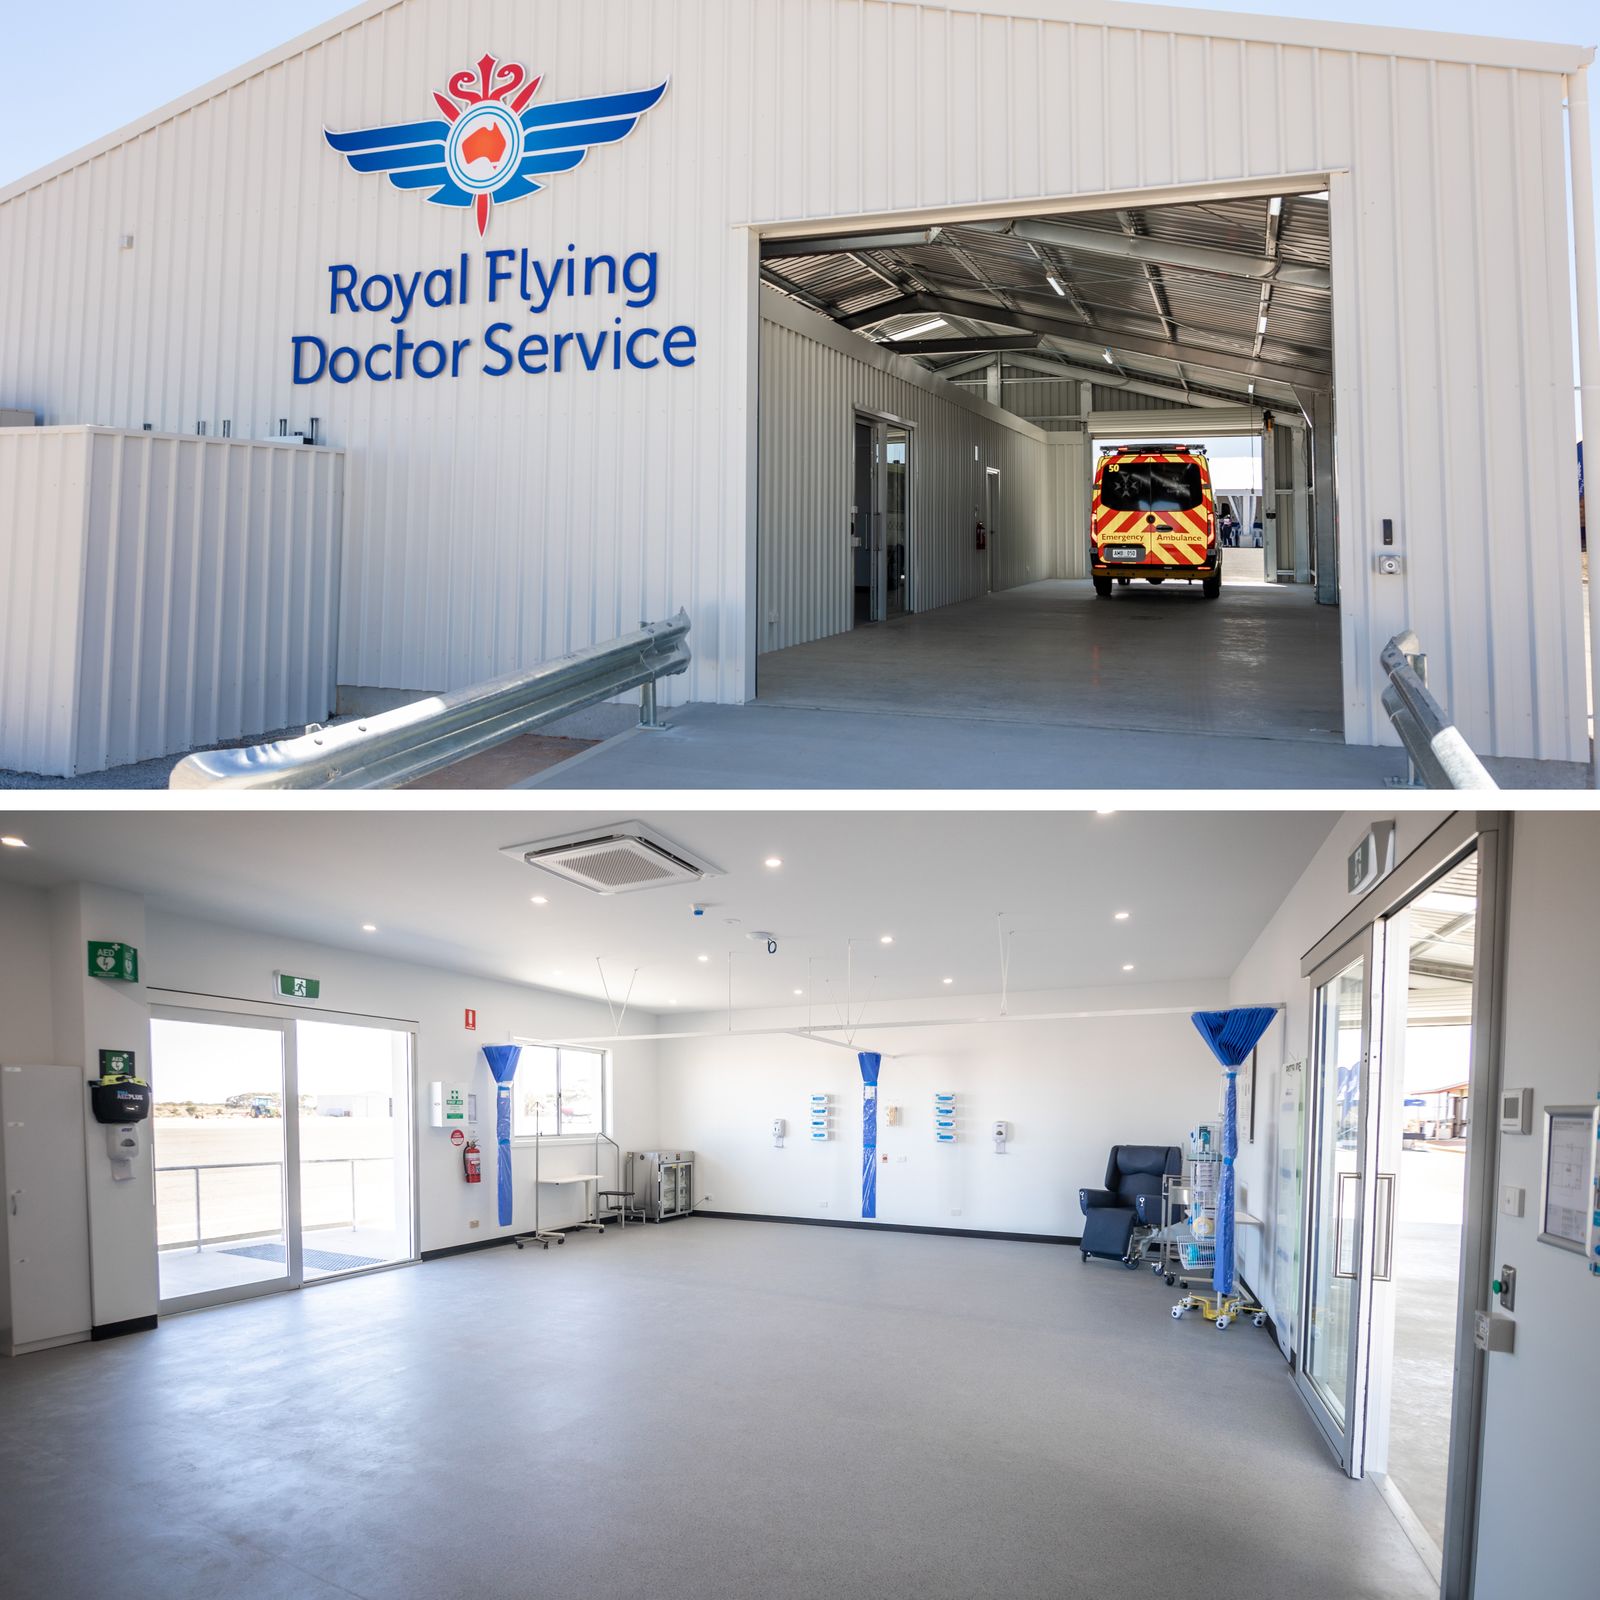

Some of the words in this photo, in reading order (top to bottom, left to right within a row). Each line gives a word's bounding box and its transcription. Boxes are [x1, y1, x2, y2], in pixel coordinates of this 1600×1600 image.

[328, 252, 469, 324] Royal
[485, 243, 658, 314] Flying
[291, 328, 470, 385] Doctor
[482, 316, 697, 377] Service
[1108, 464, 1120, 473] 50
[1101, 533, 1144, 542] Emergency
[1156, 534, 1202, 542] Ambulance
[97, 948, 115, 957] AED
